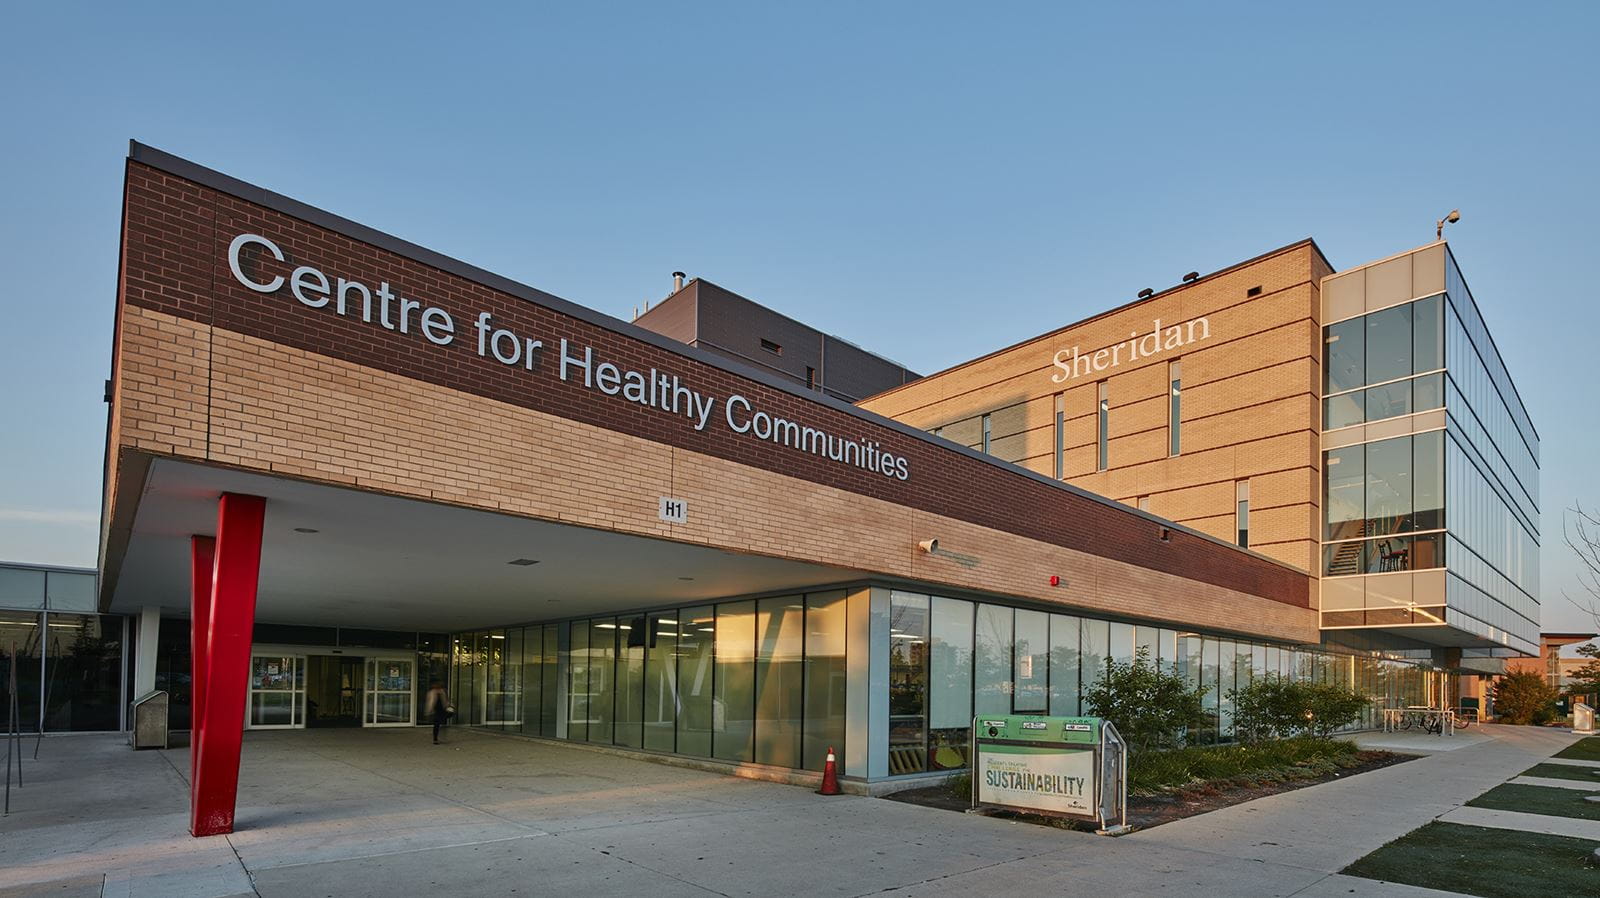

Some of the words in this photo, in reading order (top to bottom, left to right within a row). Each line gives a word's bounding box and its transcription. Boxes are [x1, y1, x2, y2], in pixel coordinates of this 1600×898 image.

[228, 233, 455, 345] Centre
[474, 312, 543, 371] for
[559, 338, 714, 431] Healthy
[726, 395, 909, 481] Communities
[1051, 317, 1212, 383] Sheridan
[665, 501, 681, 518] H1
[986, 770, 1085, 796] SUSTAINABILITY
